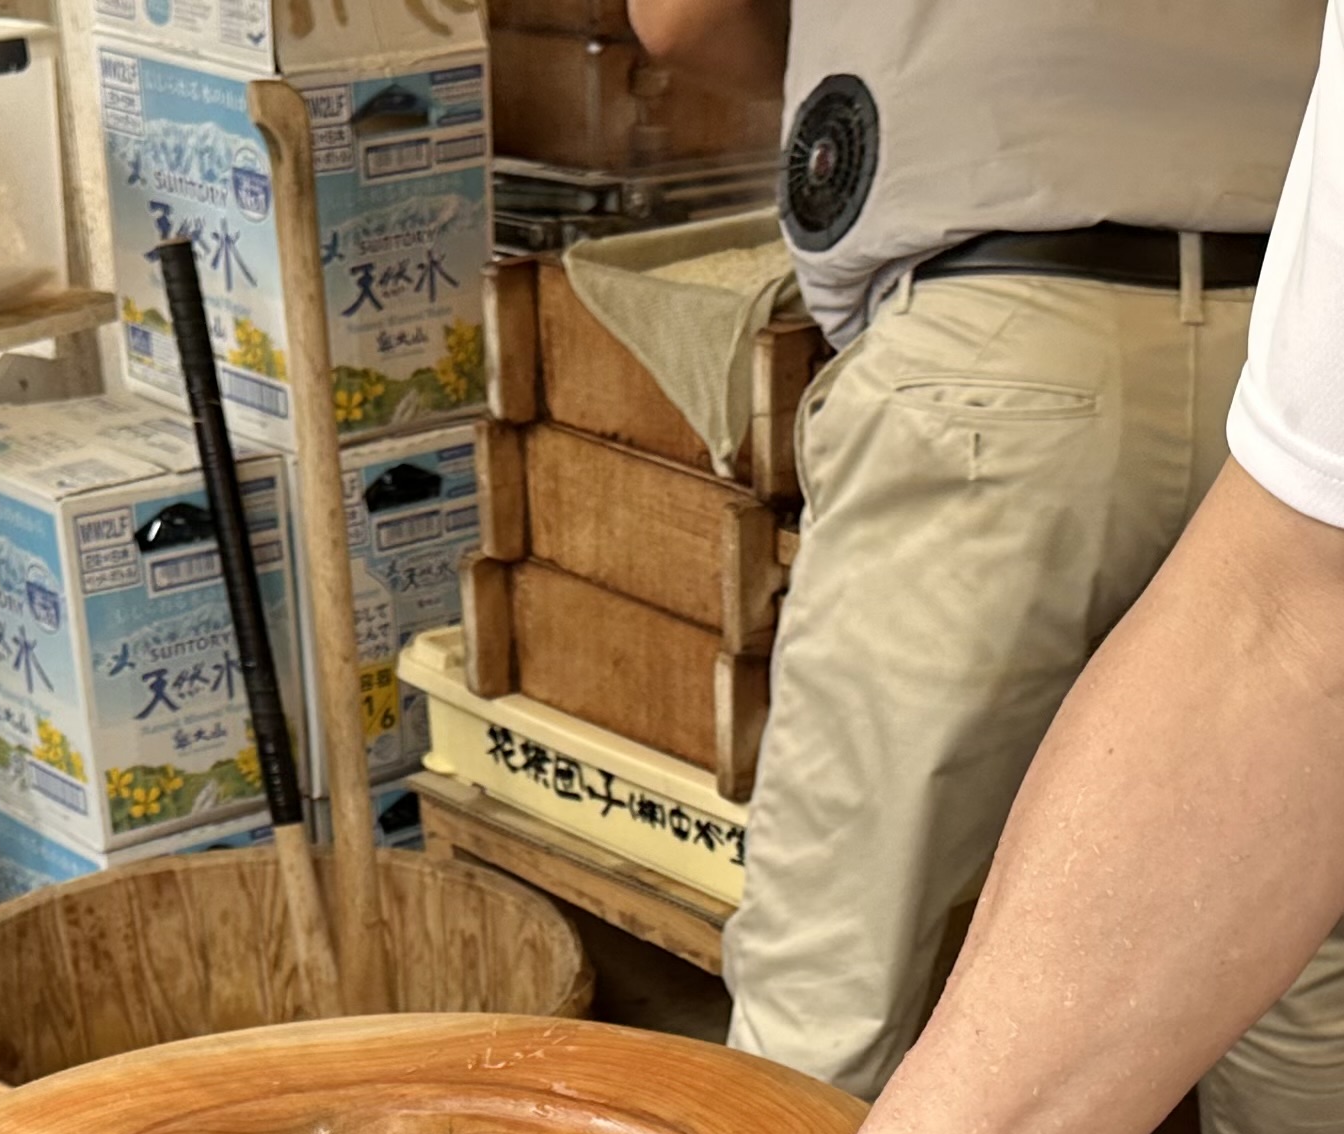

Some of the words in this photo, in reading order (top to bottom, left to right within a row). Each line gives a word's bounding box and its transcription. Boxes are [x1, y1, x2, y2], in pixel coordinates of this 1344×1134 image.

[341, 250, 459, 317] 天然水
[150, 632, 233, 663] SUNTORY
[134, 651, 243, 720] 天然水
